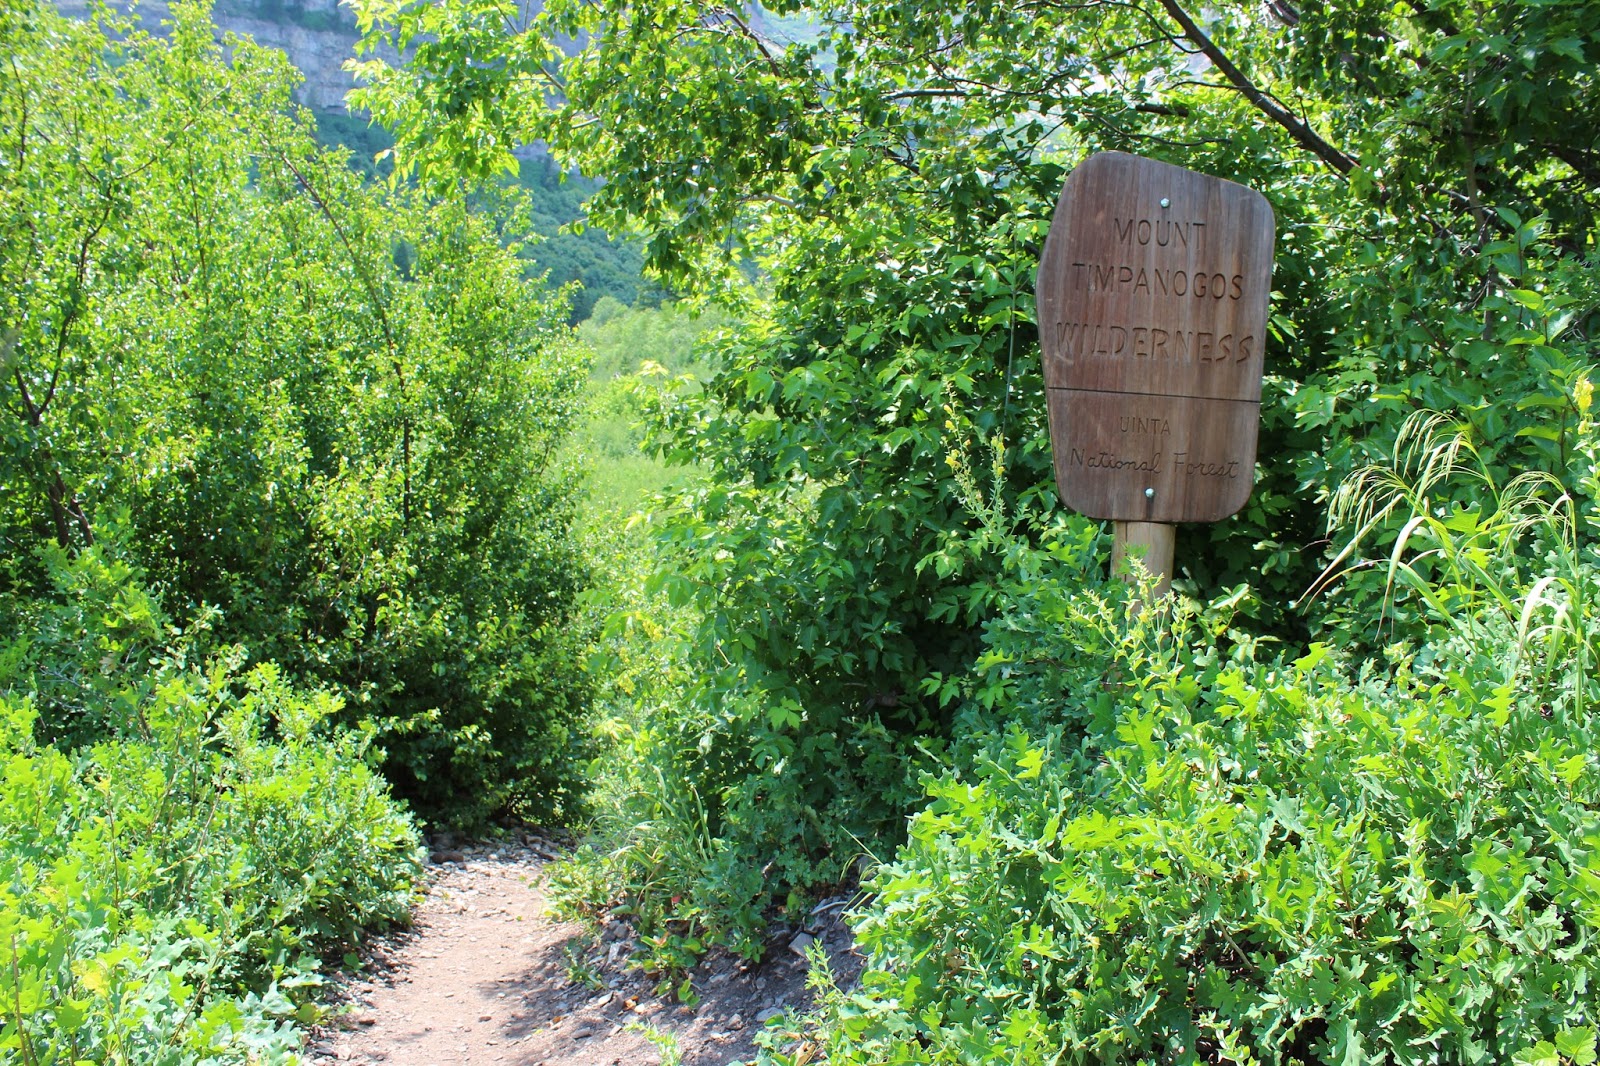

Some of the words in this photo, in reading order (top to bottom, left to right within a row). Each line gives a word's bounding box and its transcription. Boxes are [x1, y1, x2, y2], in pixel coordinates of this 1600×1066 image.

[1114, 217, 1206, 249] MOUNT
[1072, 263, 1243, 300] TIMPANOGOS
[1056, 322, 1254, 364] WILDERNESS
[1120, 416, 1171, 435] UINTA
[1070, 448, 1161, 474] National
[1174, 452, 1239, 478] Forest
